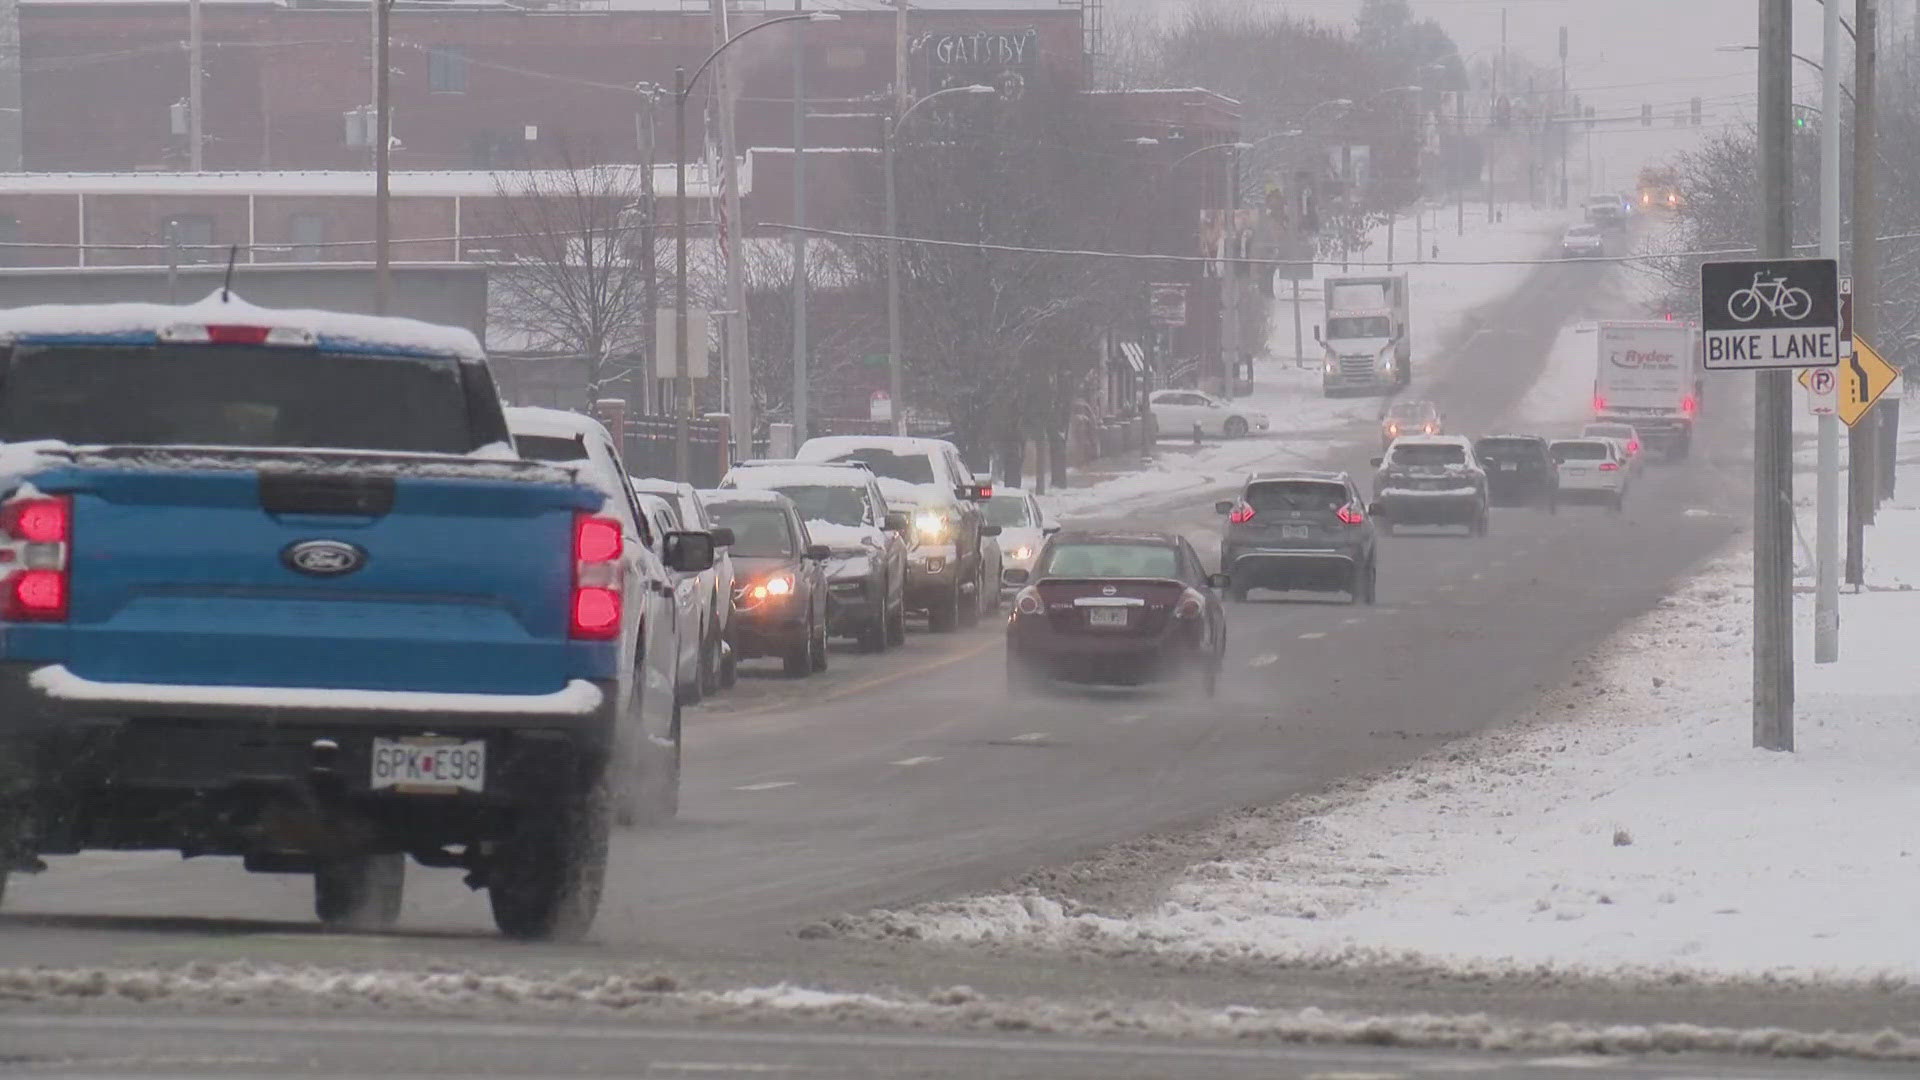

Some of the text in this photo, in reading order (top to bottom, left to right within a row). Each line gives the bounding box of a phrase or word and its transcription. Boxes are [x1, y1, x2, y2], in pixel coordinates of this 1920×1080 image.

[936, 35, 1027, 65] GATSBY
[1625, 349, 1674, 364] Ryder
[1709, 333, 1834, 361] BIKE LANE
[375, 748, 480, 780] 6PK E98
